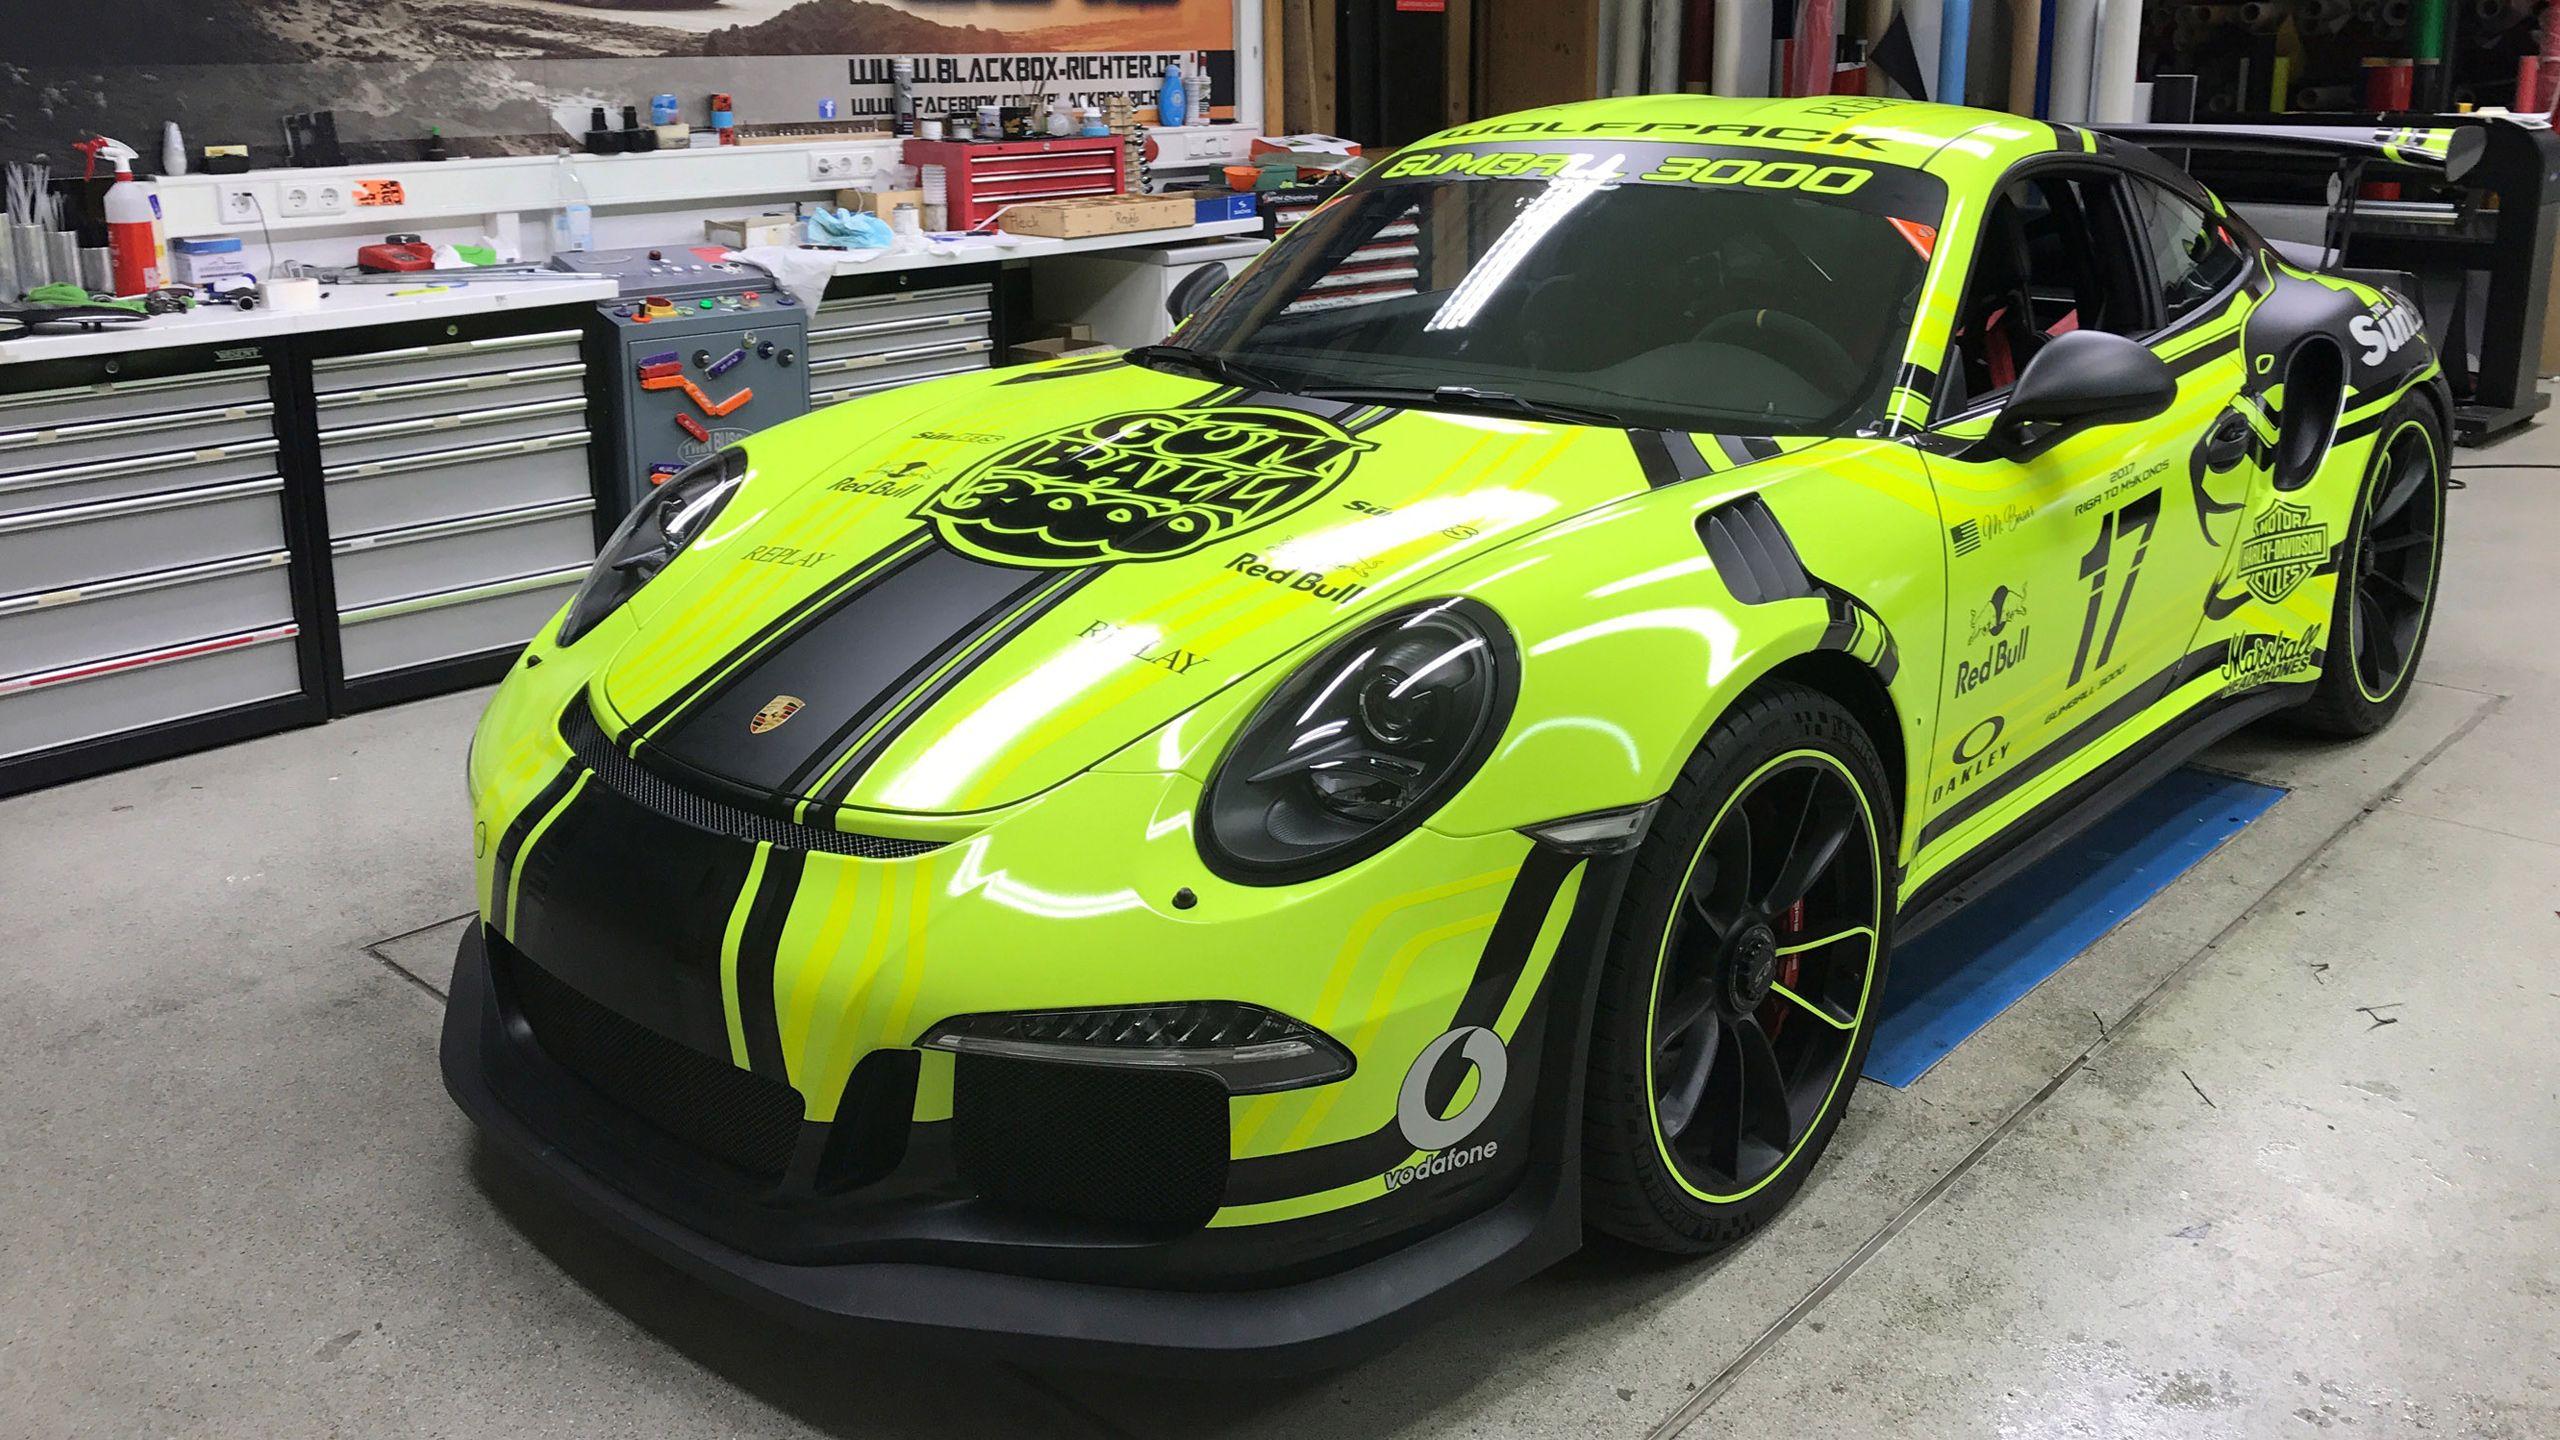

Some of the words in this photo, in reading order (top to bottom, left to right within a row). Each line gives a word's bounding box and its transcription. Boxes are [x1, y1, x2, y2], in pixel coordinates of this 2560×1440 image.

[1438, 120, 1891, 152] WOLFPACK
[1639, 156, 1875, 196] 3000
[826, 476, 879, 493] Red
[868, 480, 924, 499] Bull
[2110, 462, 2136, 483] 2017
[2075, 494, 2102, 516] RIGA
[2104, 485, 2120, 501] TO
[2258, 510, 2306, 535] MOTOR
[741, 545, 837, 568] REPLAY
[2241, 532, 2323, 569] HARLEY-DAVIDSON
[1225, 552, 1296, 584] Red
[1289, 571, 1367, 604] Bull
[2065, 486, 2163, 690] 17
[2255, 564, 2301, 596] CYCLES
[1075, 619, 1210, 675] RLAY
[1954, 644, 1993, 699] Red
[1993, 625, 2029, 676] Bull
[2220, 622, 2322, 681] Marshall
[2221, 656, 2311, 699] HEADPHONES
[1931, 742, 2010, 805] OAKLEY
[1384, 1140, 1499, 1191] vodafone
